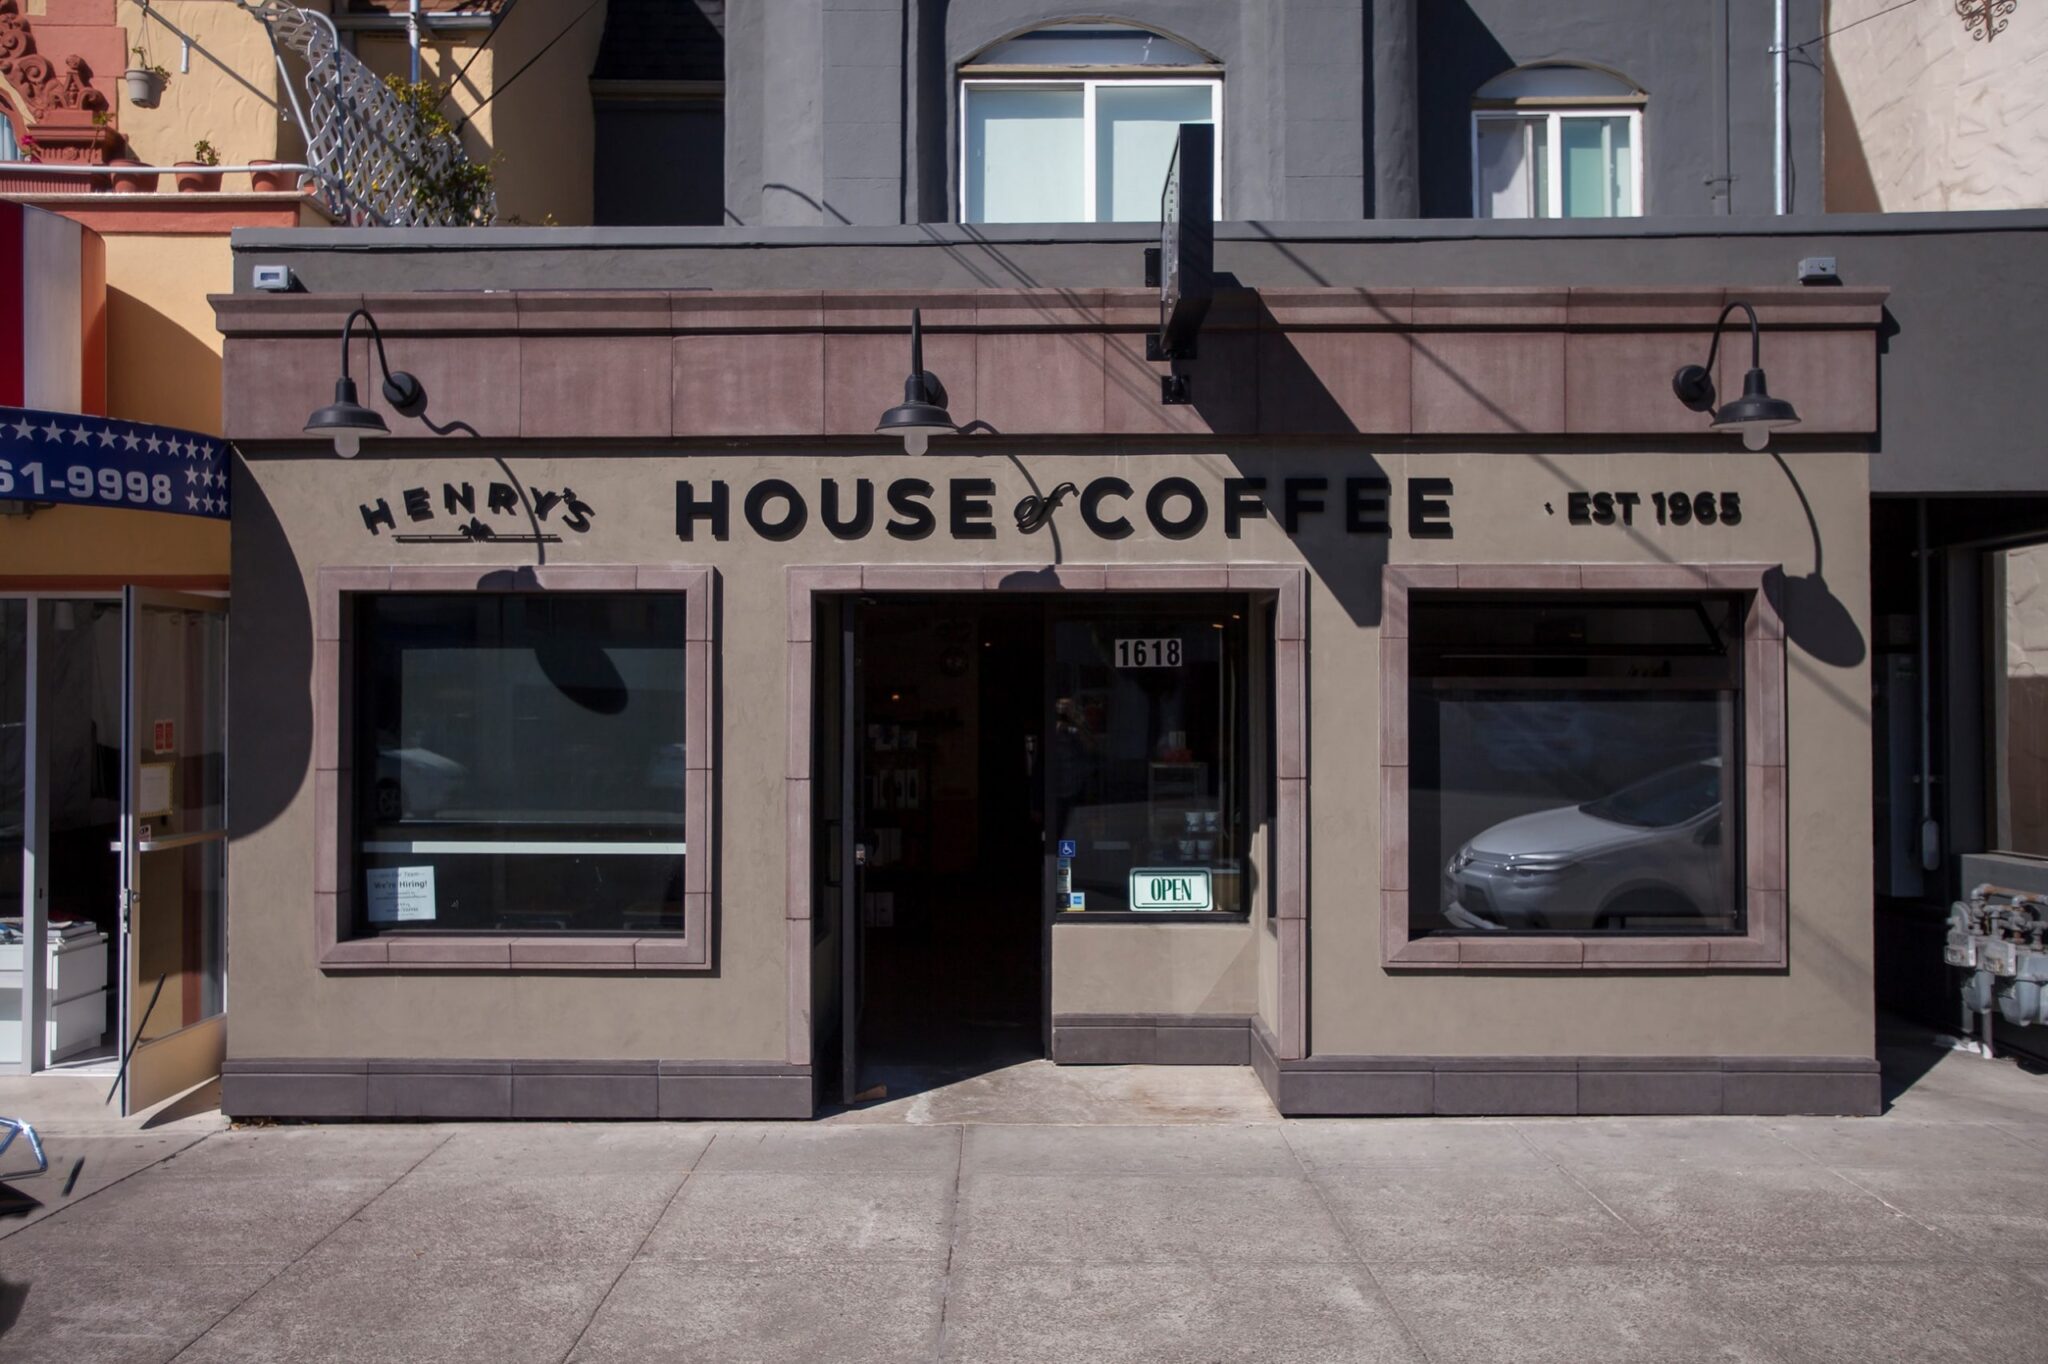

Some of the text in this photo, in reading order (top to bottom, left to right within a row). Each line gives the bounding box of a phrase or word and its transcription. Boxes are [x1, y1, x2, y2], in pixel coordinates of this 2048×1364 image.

[359, 482, 596, 535] HENRY'S
[676, 477, 1454, 541] HOUSE of COFFEE
[1568, 491, 1742, 526] EST 1965
[1119, 640, 1180, 666] 1618
[399, 879, 428, 888] Hiring!
[1151, 878, 1192, 901] OPEN
